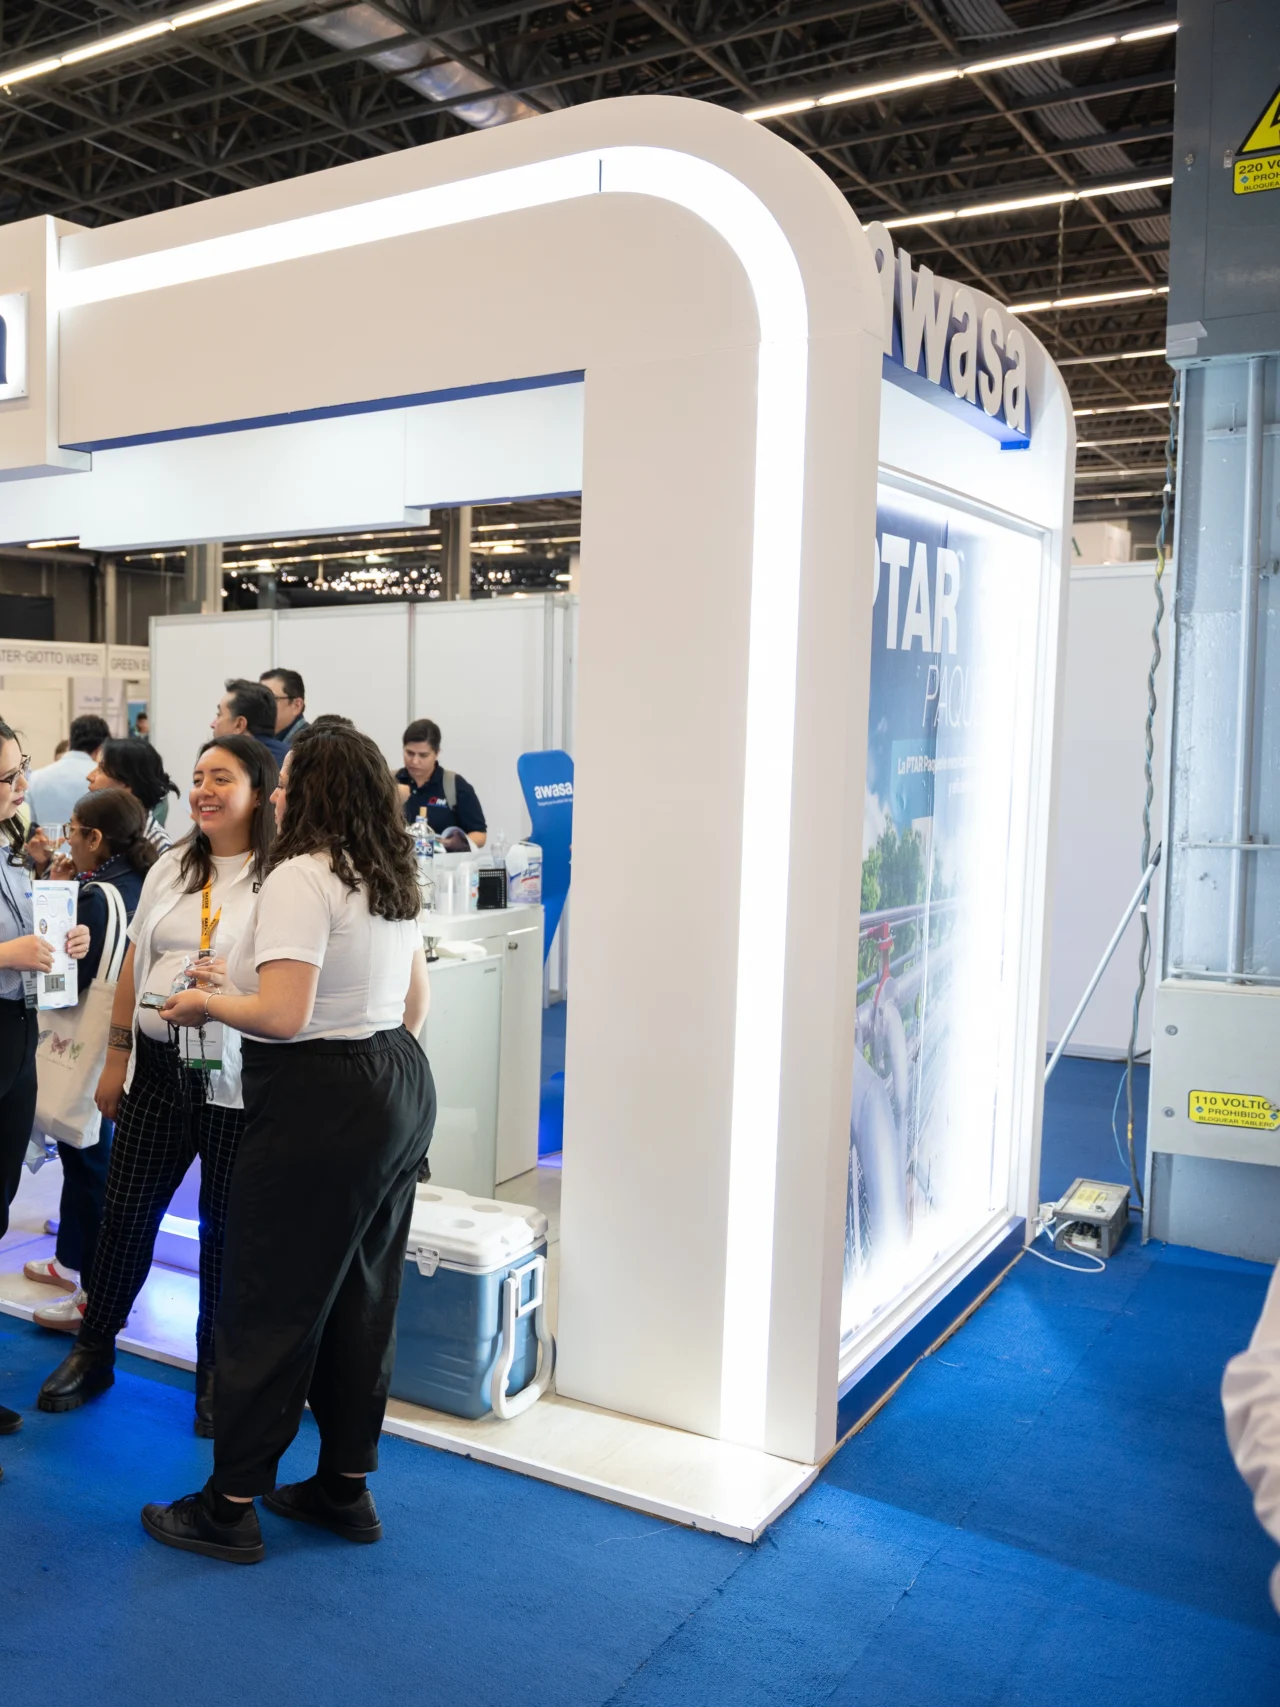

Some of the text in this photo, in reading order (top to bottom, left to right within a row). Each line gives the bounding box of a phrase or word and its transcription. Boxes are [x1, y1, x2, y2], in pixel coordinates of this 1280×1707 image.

[1239, 162, 1263, 174] 220
[111, 657, 140, 671] GREEN
[906, 755, 923, 774] PTAR
[534, 782, 573, 799] awasa
[1194, 1095, 1273, 1111] 110 VOLTIO
[1208, 1107, 1266, 1120] PROHIBIDO
[1198, 1115, 1275, 1128] BLOQUEAR TABLERO
